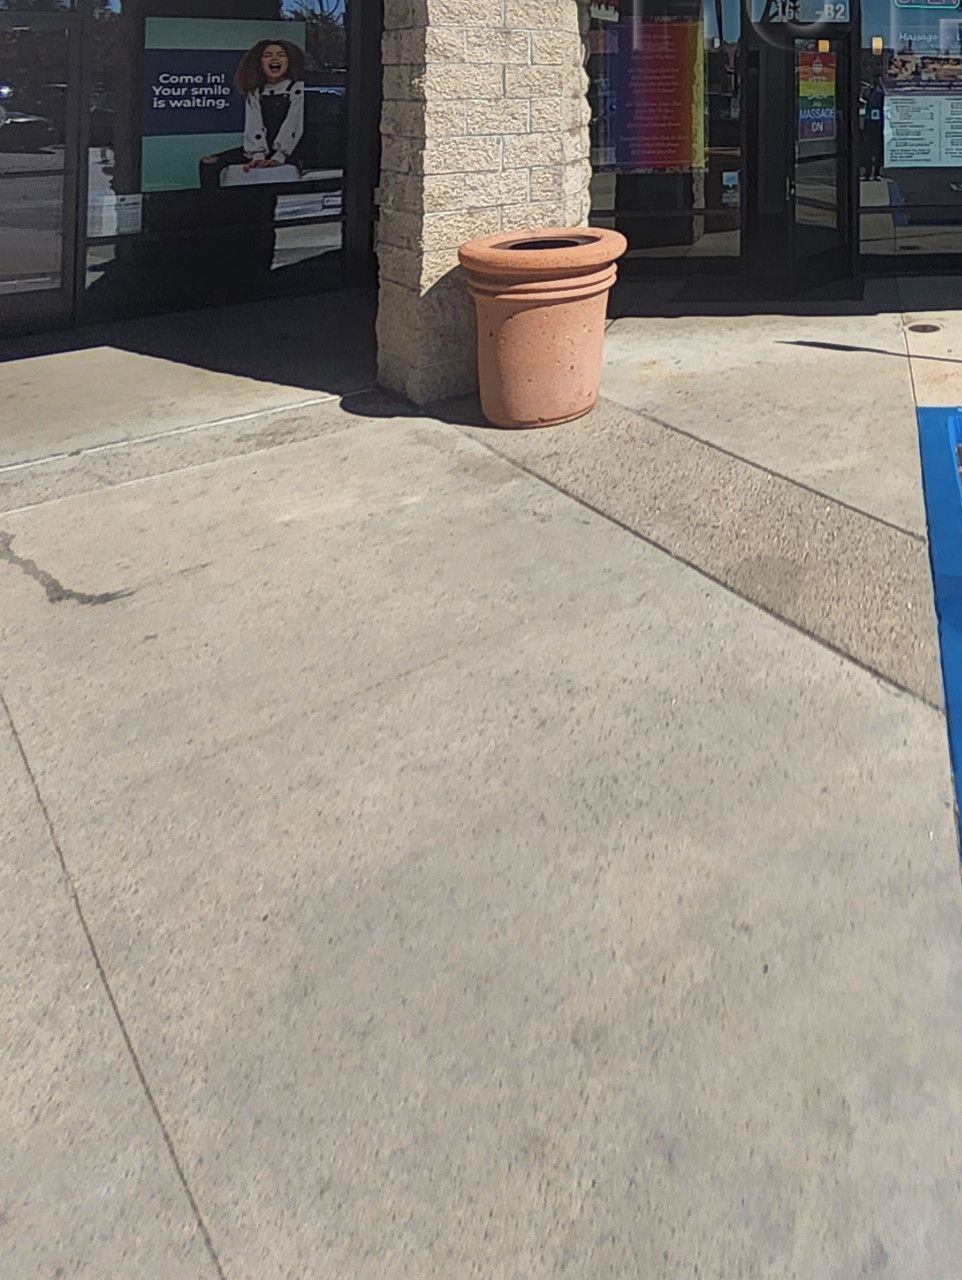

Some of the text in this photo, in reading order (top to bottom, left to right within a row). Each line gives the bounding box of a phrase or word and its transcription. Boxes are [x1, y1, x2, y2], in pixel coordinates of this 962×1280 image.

[159, 73, 225, 84] Come in!
[152, 84, 231, 96] Your smile
[153, 96, 230, 109] is waiting.
[800, 108, 835, 119] MASSAGE
[811, 122, 824, 133] ON
